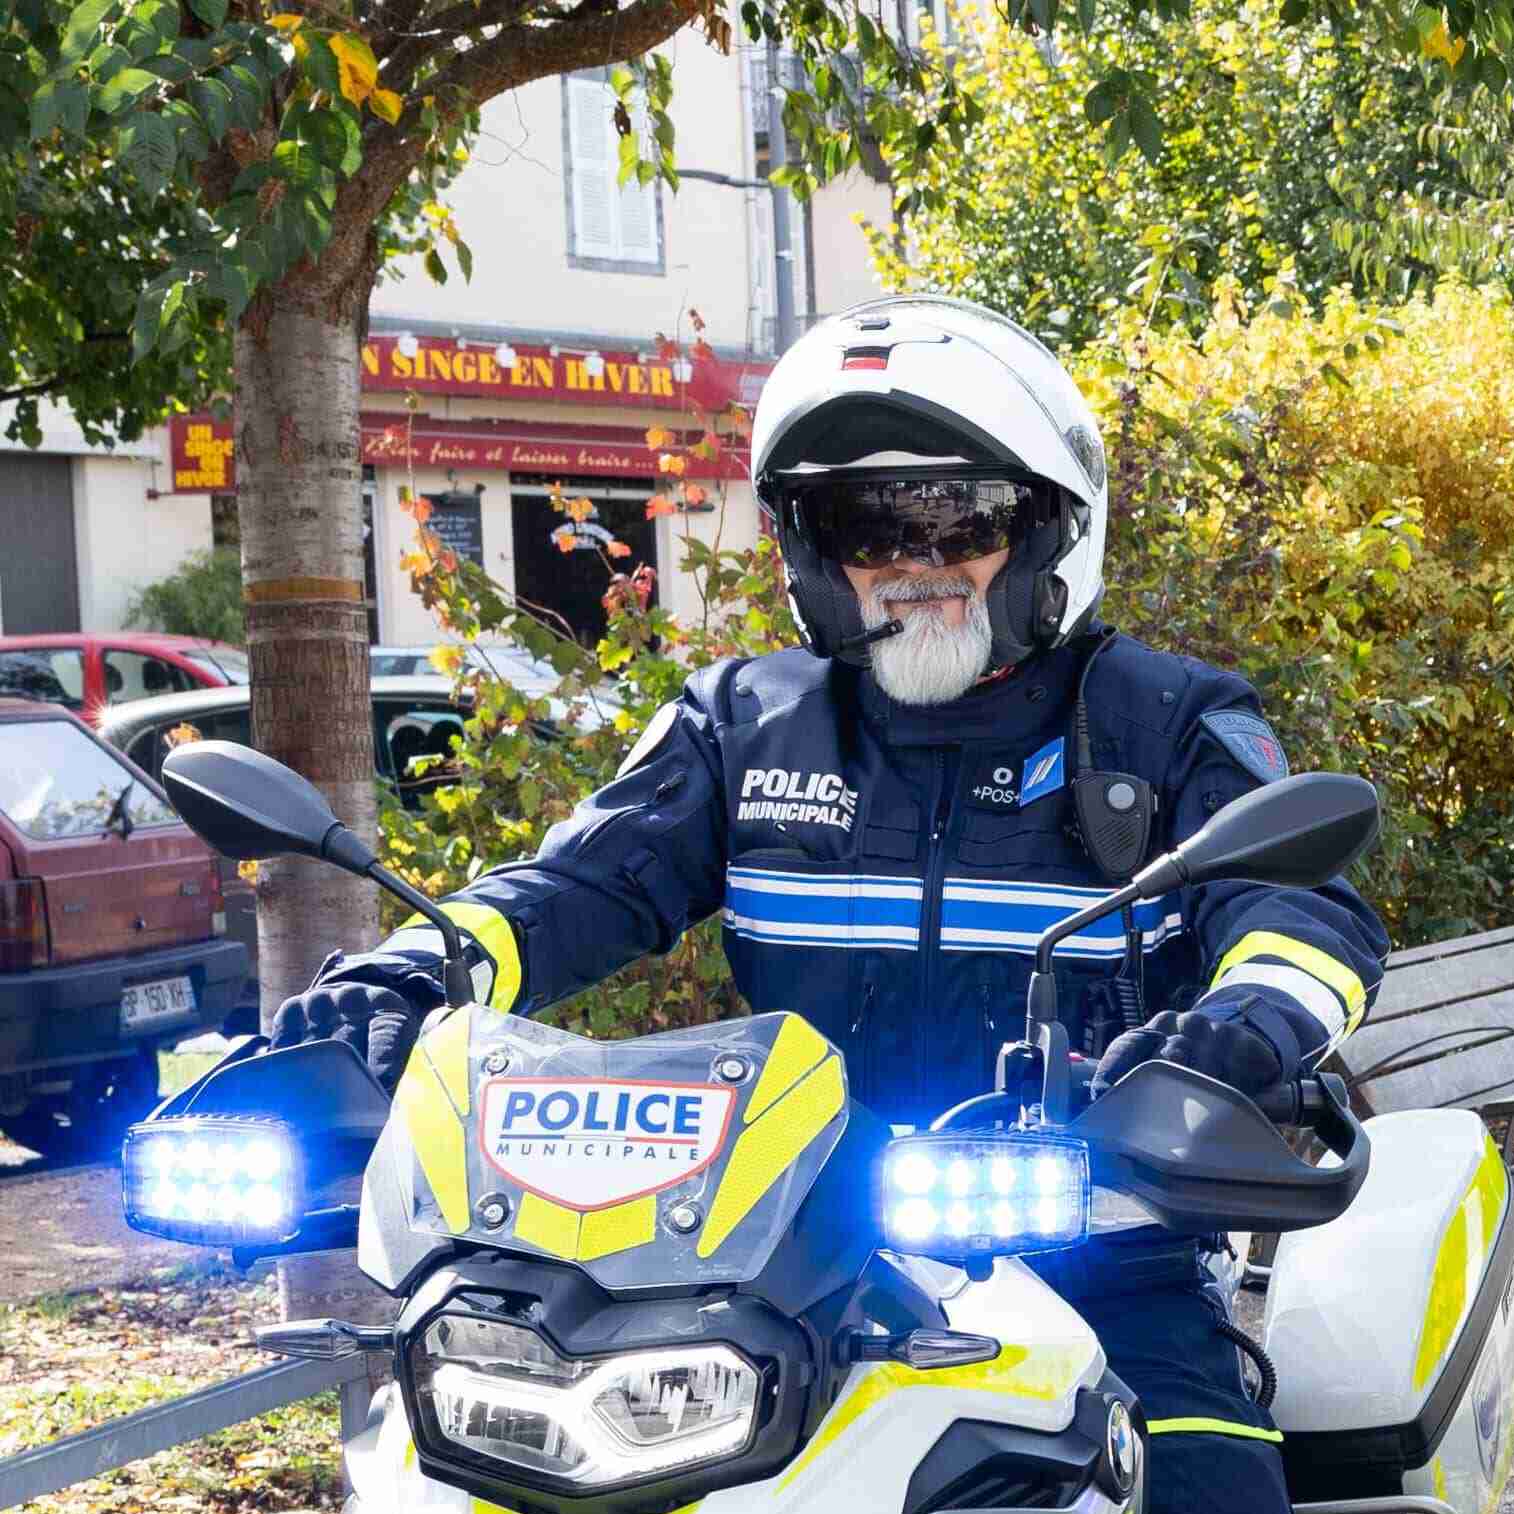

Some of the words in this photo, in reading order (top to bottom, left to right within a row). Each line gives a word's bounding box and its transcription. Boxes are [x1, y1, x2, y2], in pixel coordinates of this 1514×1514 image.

[361, 343, 380, 376] N
[391, 345, 502, 384] SINGE
[510, 355, 554, 387] EN
[565, 359, 673, 396] HIVER
[741, 768, 859, 814] POLICE
[737, 800, 853, 832] MUNICIPALE
[501, 1090, 702, 1135] POLICE
[495, 1143, 699, 1161] MUNICIPALE
